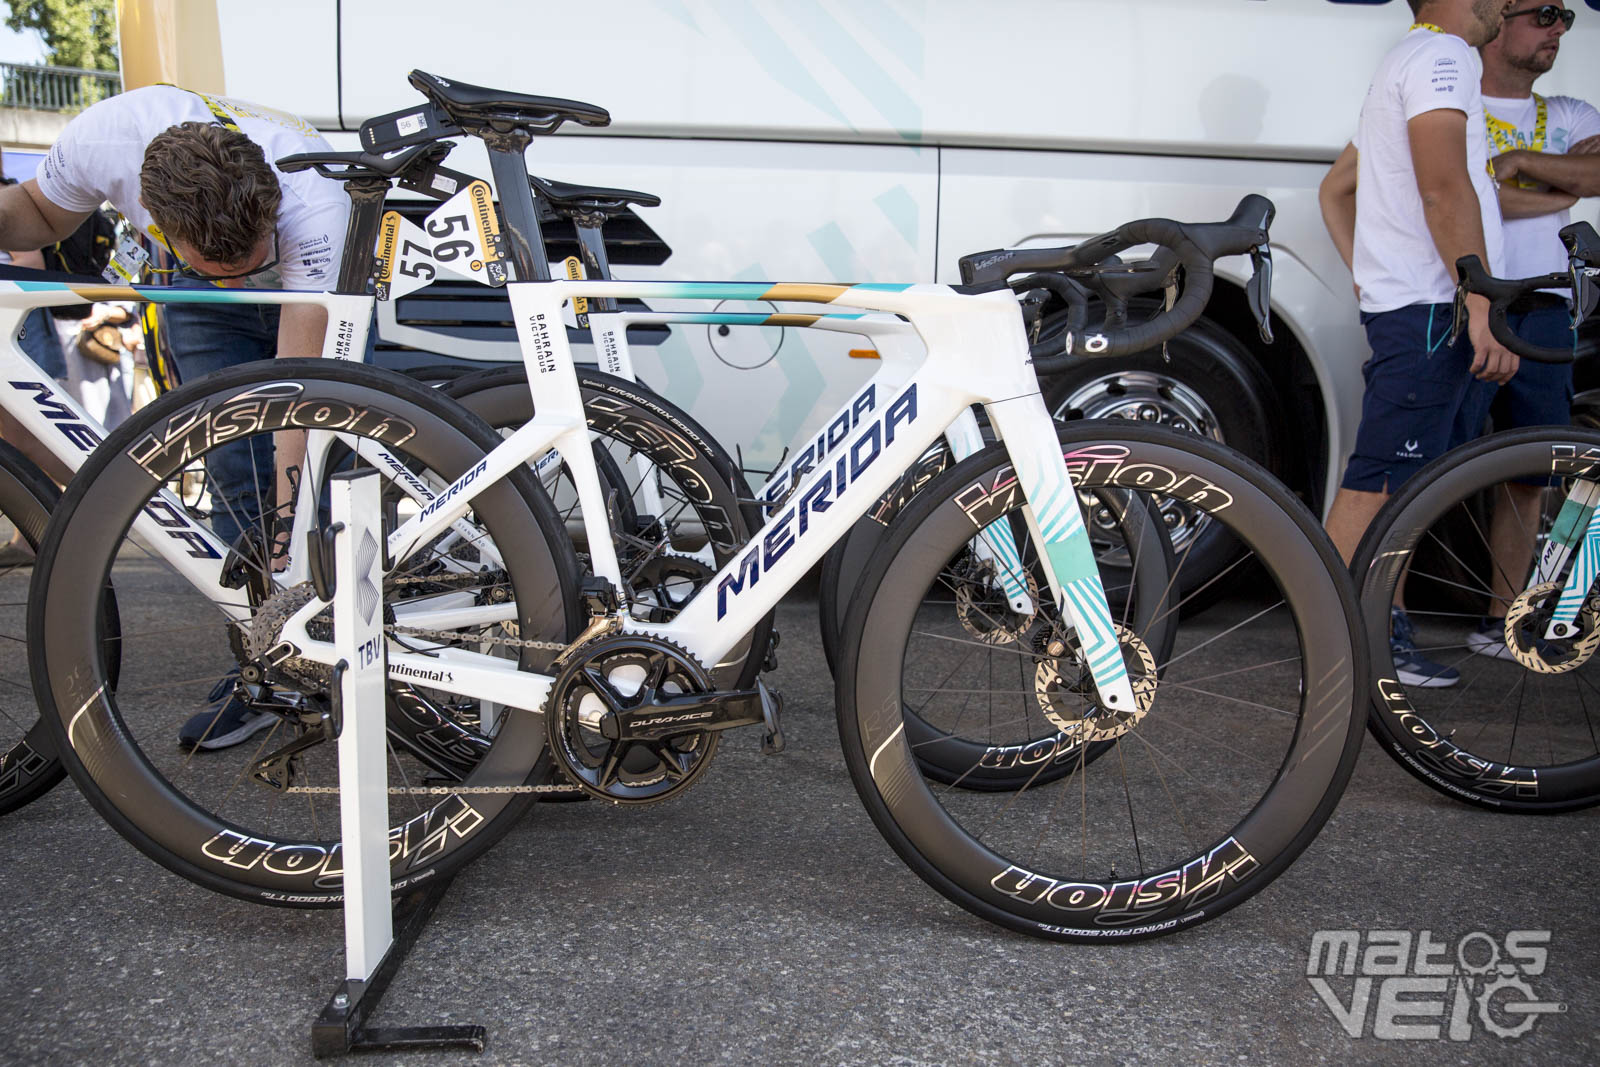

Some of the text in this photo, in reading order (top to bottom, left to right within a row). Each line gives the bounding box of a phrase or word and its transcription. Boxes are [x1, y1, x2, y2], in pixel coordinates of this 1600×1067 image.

[427, 214, 475, 262] 56
[399, 240, 436, 280] 57
[335, 320, 348, 360] AHRAIN
[529, 315, 547, 374] VICTORIOUS
[536, 313, 556, 372] BAHRAIN
[602, 332, 614, 373] VICTORIOUS
[607, 331, 621, 372] BAHRAIN
[606, 386, 647, 405] GRAND
[645, 402, 673, 420] PRIX
[670, 417, 700, 441] 5000
[760, 383, 876, 516] ERIDA
[378, 453, 436, 501] MERIDA
[420, 460, 487, 523] MERIDA
[717, 382, 919, 623] MERIDA
[358, 633, 381, 670] TBV
[388, 663, 444, 682] ntinental
[629, 711, 714, 728] DURA-ACE
[286, 895, 327, 903] 5000
[1061, 927, 1101, 937] 5000
[1100, 927, 1134, 937] PRIX
[1132, 919, 1177, 935] GRAND
